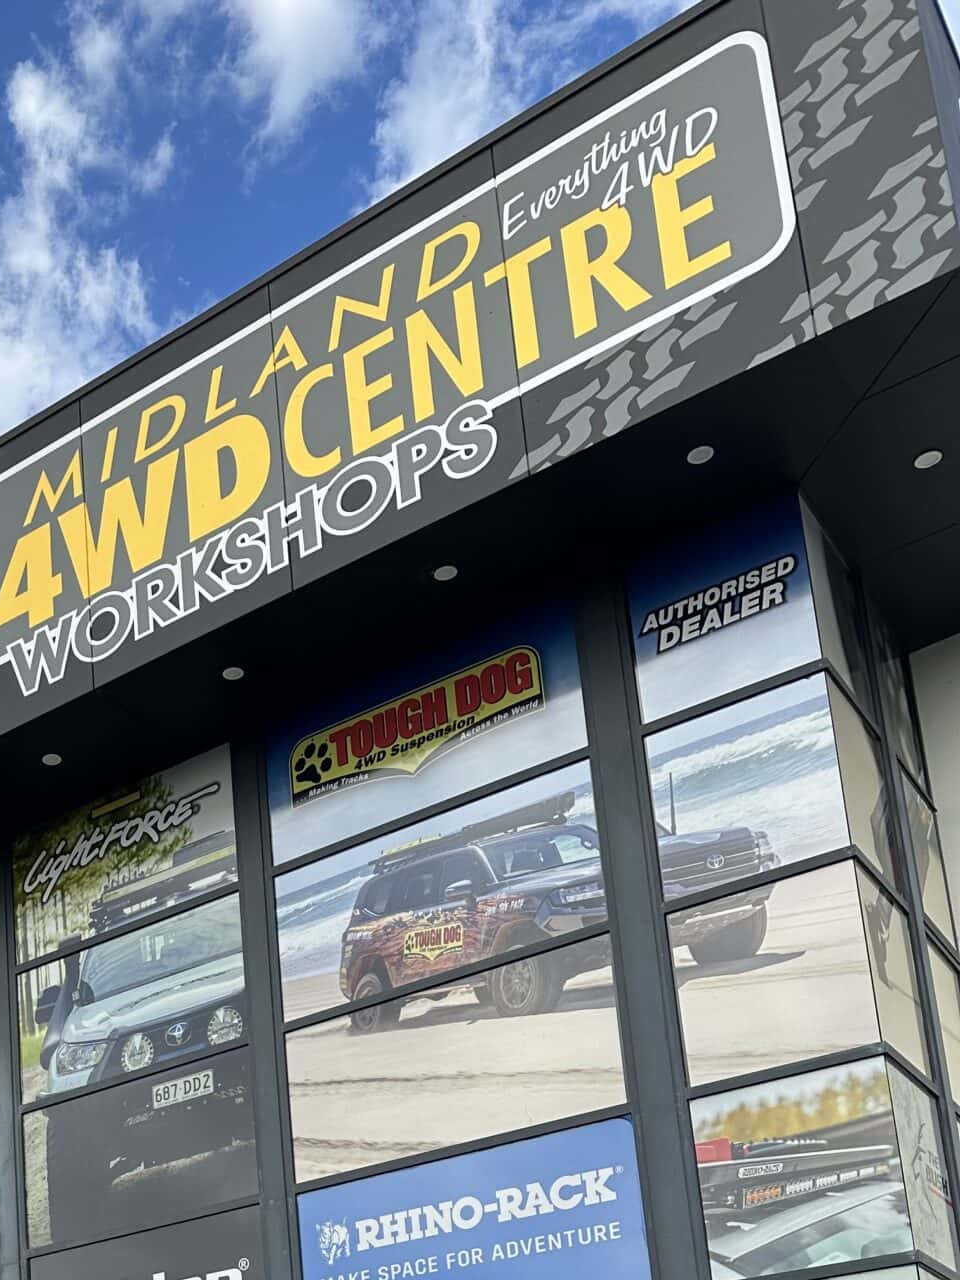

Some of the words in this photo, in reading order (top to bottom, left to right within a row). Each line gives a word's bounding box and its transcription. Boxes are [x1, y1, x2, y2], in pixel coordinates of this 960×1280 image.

[502, 108, 667, 240] Everything
[600, 106, 718, 210] 4WD
[23, 221, 481, 527] MIDLAND
[5, 399, 498, 697] WORKSHOPS
[641, 555, 795, 633] AUTHORISED
[658, 581, 785, 652] DEALER
[328, 685, 449, 767] TOUGH
[454, 652, 533, 718] DOG
[354, 751, 386, 771] 4WD
[391, 716, 476, 757] Suspension
[511, 699, 539, 715] World
[414, 927, 442, 949] TOUGH
[443, 925, 462, 944] DOG
[354, 1167, 617, 1251] RHINO-RACK
[446, 1248, 483, 1270] FOR
[492, 1222, 622, 1261] ADVENTURE
